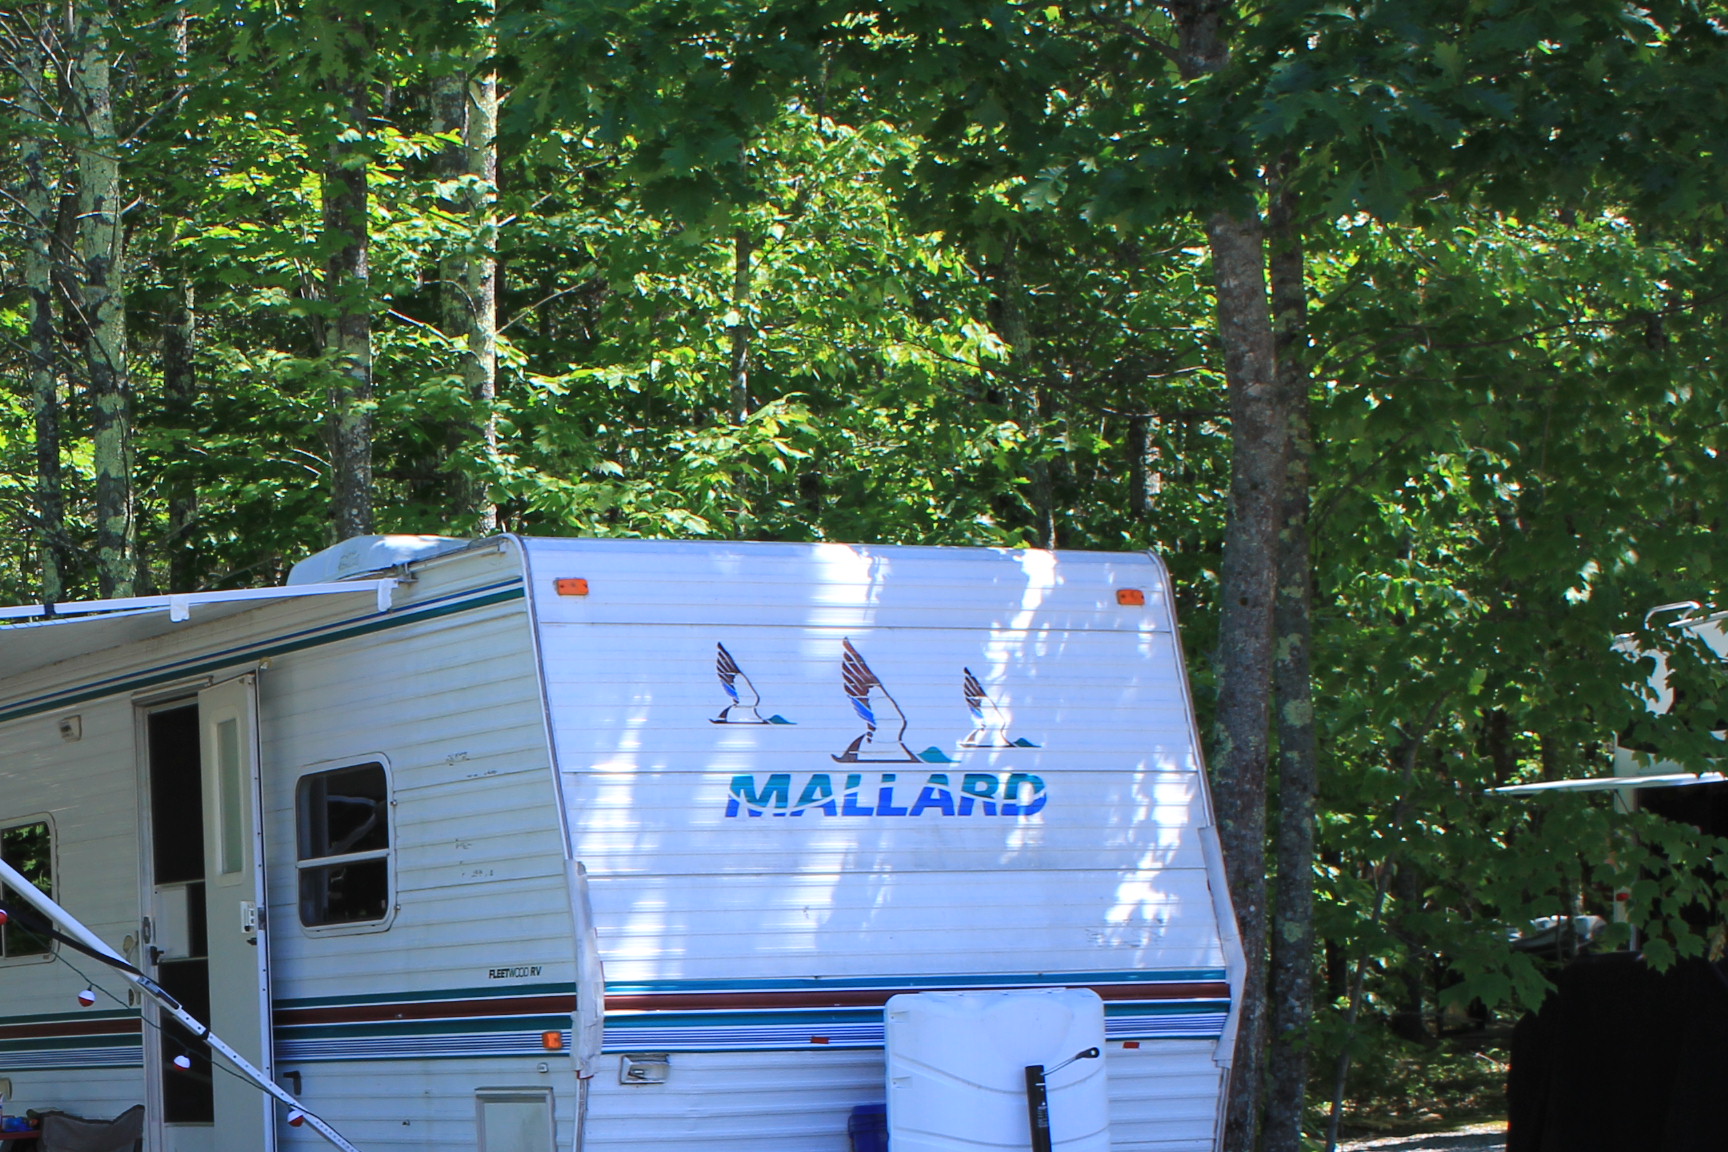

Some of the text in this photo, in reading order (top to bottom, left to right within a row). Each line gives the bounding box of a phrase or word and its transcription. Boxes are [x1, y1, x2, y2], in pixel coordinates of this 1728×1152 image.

[725, 773, 1047, 817] MALLARD
[488, 966, 542, 979] FLEETWOOD RV
